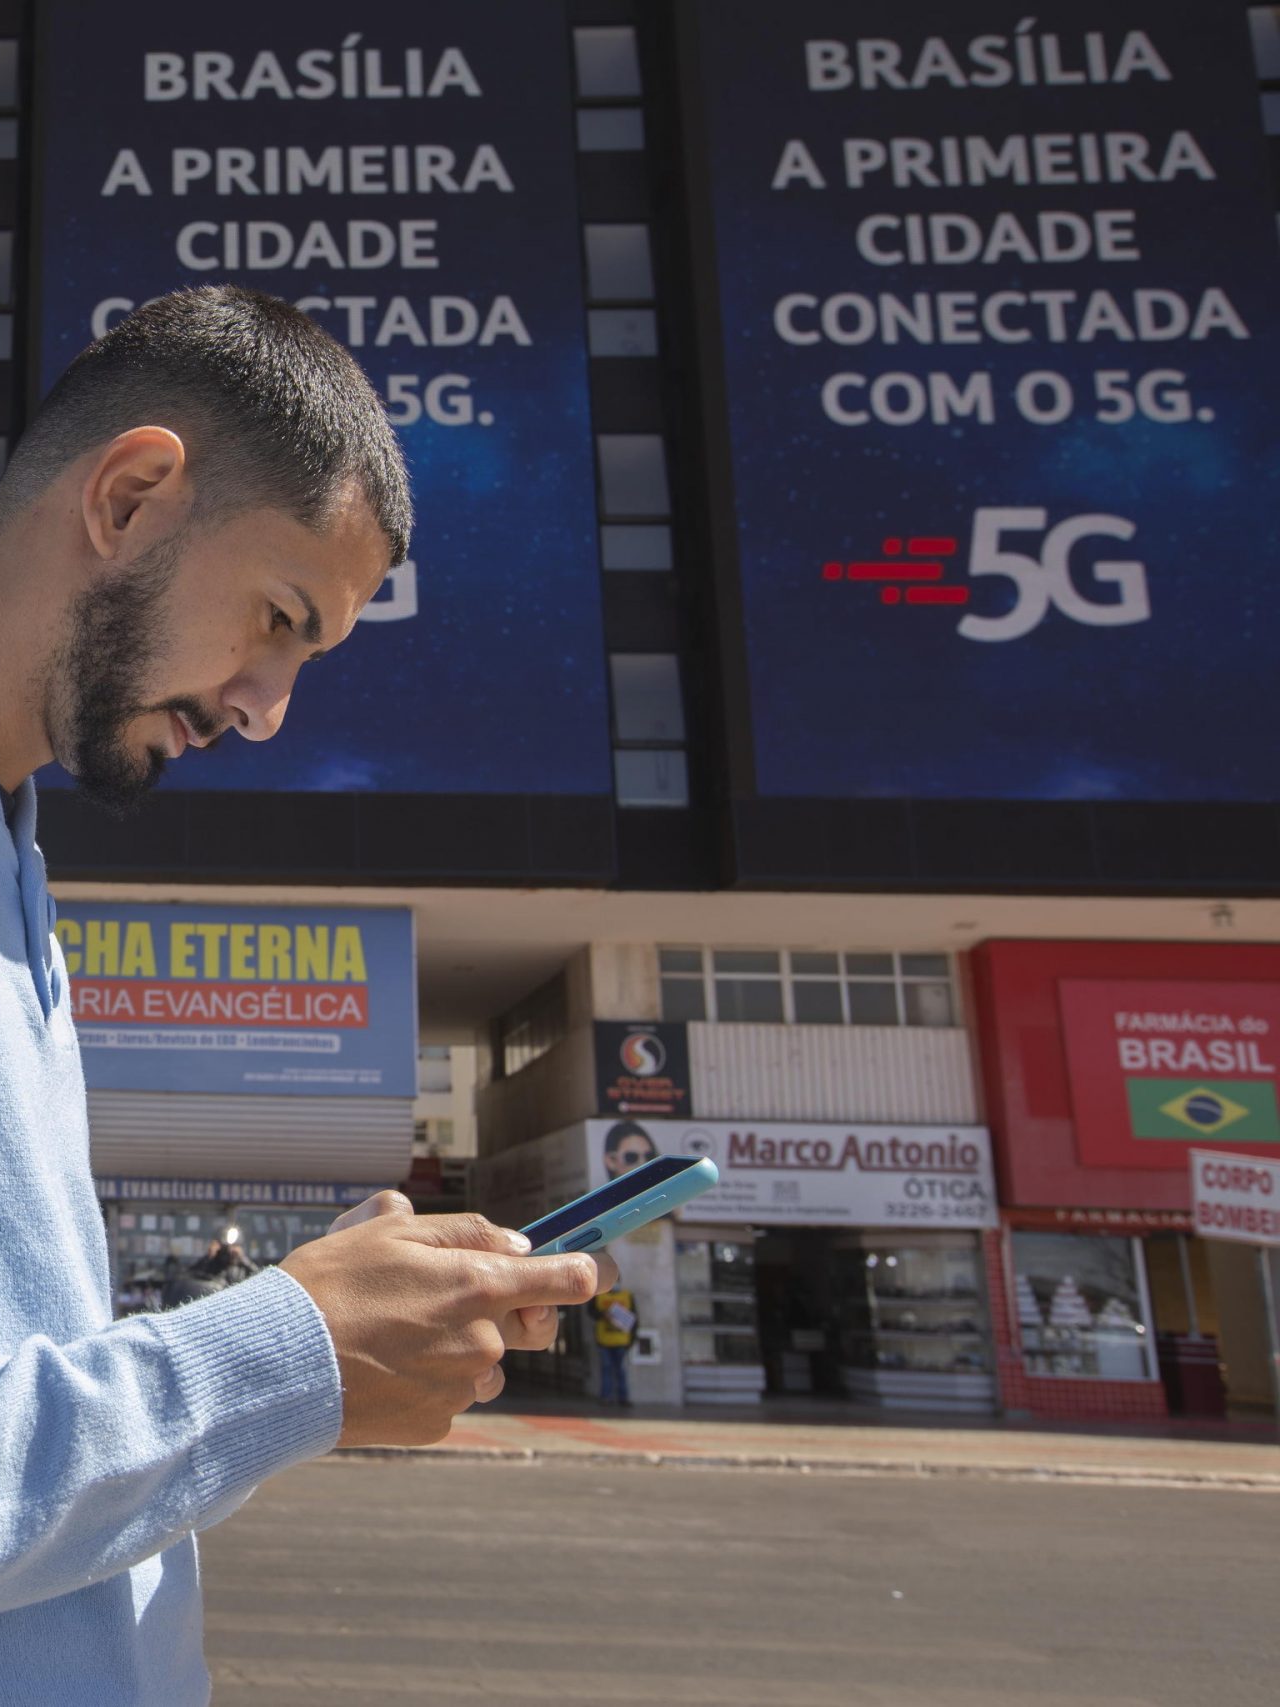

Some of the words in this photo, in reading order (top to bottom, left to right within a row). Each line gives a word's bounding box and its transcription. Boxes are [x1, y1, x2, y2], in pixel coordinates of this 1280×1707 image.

[145, 33, 481, 101] BRASÍLIA
[805, 18, 1171, 91] BRASÍLIA
[101, 149, 152, 196] A
[172, 145, 513, 195] PRIMEIRA
[772, 140, 825, 189] A
[843, 131, 1215, 188] PRIMEIRA
[176, 220, 439, 271] CIDADE
[856, 210, 1139, 265] CIDADE
[774, 289, 1248, 345] CONECTADA
[387, 375, 494, 426] 5G.
[821, 372, 994, 425] COM
[1015, 371, 1073, 424] O
[1095, 369, 1215, 423] 5G.
[957, 507, 1150, 642] 5G
[171, 923, 368, 982] ETERNA
[143, 987, 364, 1021] EVANGÉLICA
[1114, 1009, 1236, 1034] FARMÁCIA
[1239, 1015, 1269, 1035] do
[1118, 1037, 1276, 1073] BRASIL
[728, 1132, 833, 1163] Marco
[839, 1133, 981, 1169] Antonio
[903, 1173, 987, 1201] ÓTICA
[1202, 1162, 1273, 1195] CORPO
